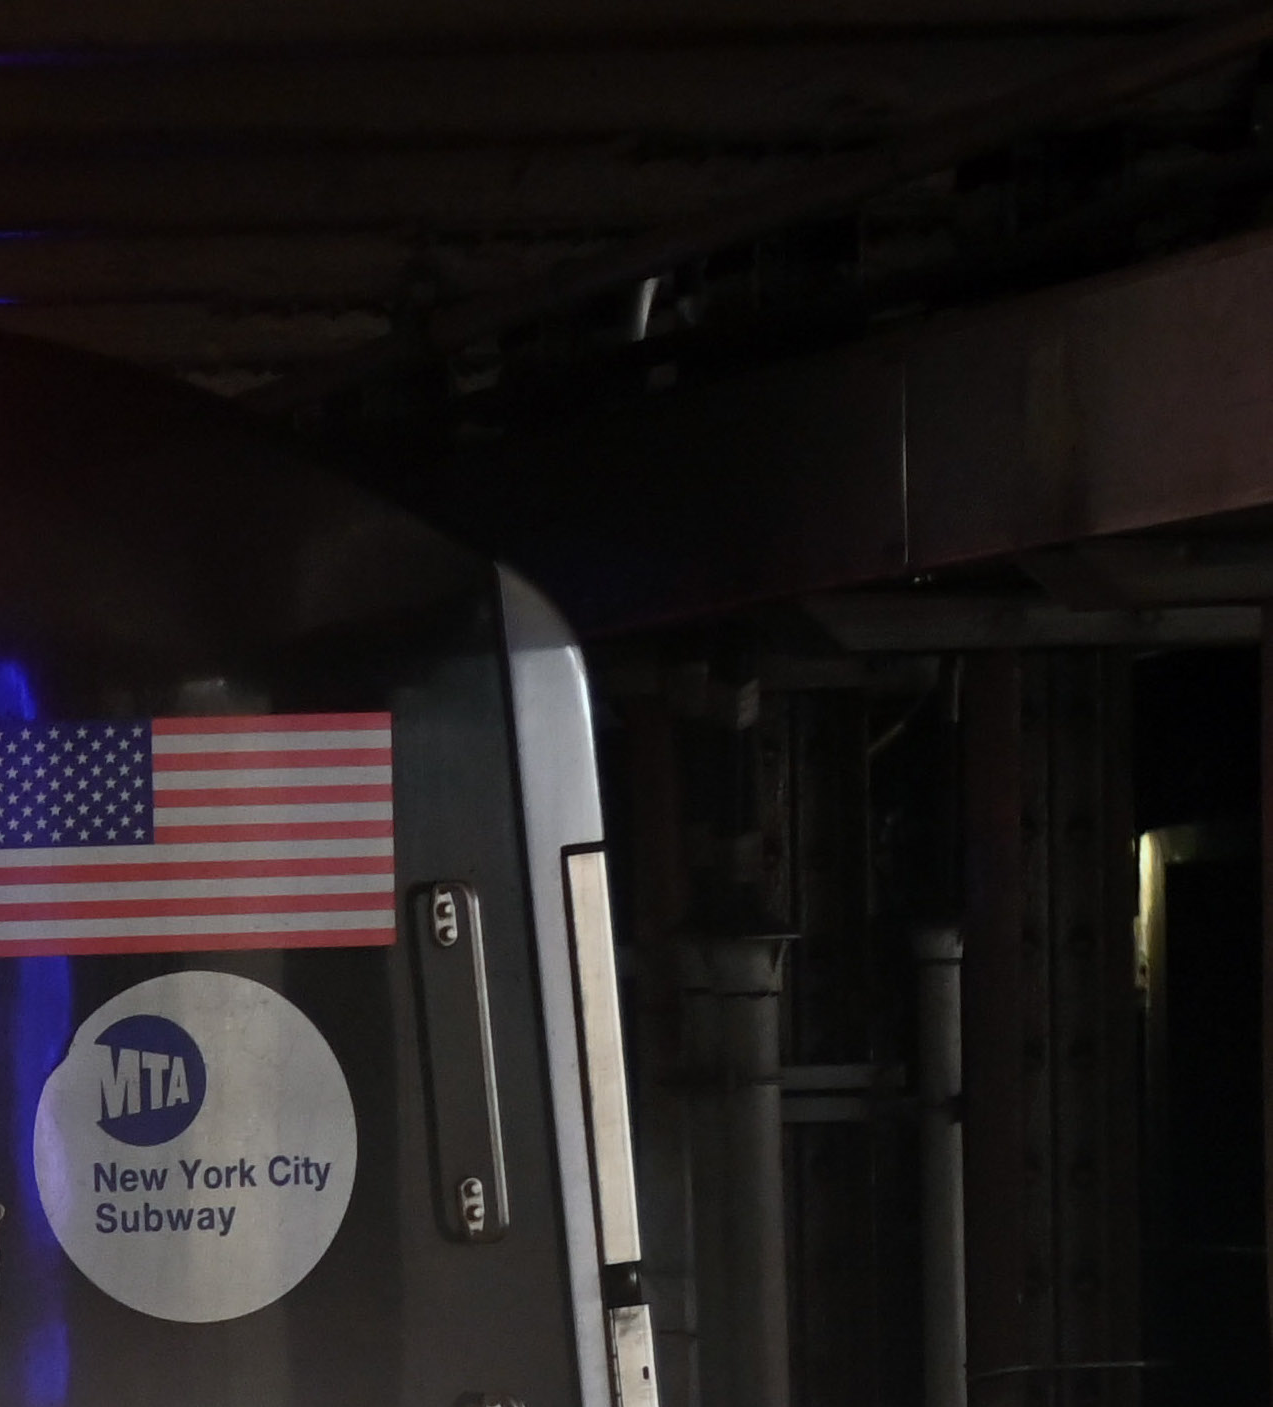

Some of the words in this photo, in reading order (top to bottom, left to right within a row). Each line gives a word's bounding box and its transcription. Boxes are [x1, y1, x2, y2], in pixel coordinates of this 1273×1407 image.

[94, 1045, 190, 1120] MTA
[93, 1162, 168, 1193] New
[179, 1158, 257, 1190] York
[268, 1155, 332, 1192] City
[95, 1202, 236, 1237] Subway
